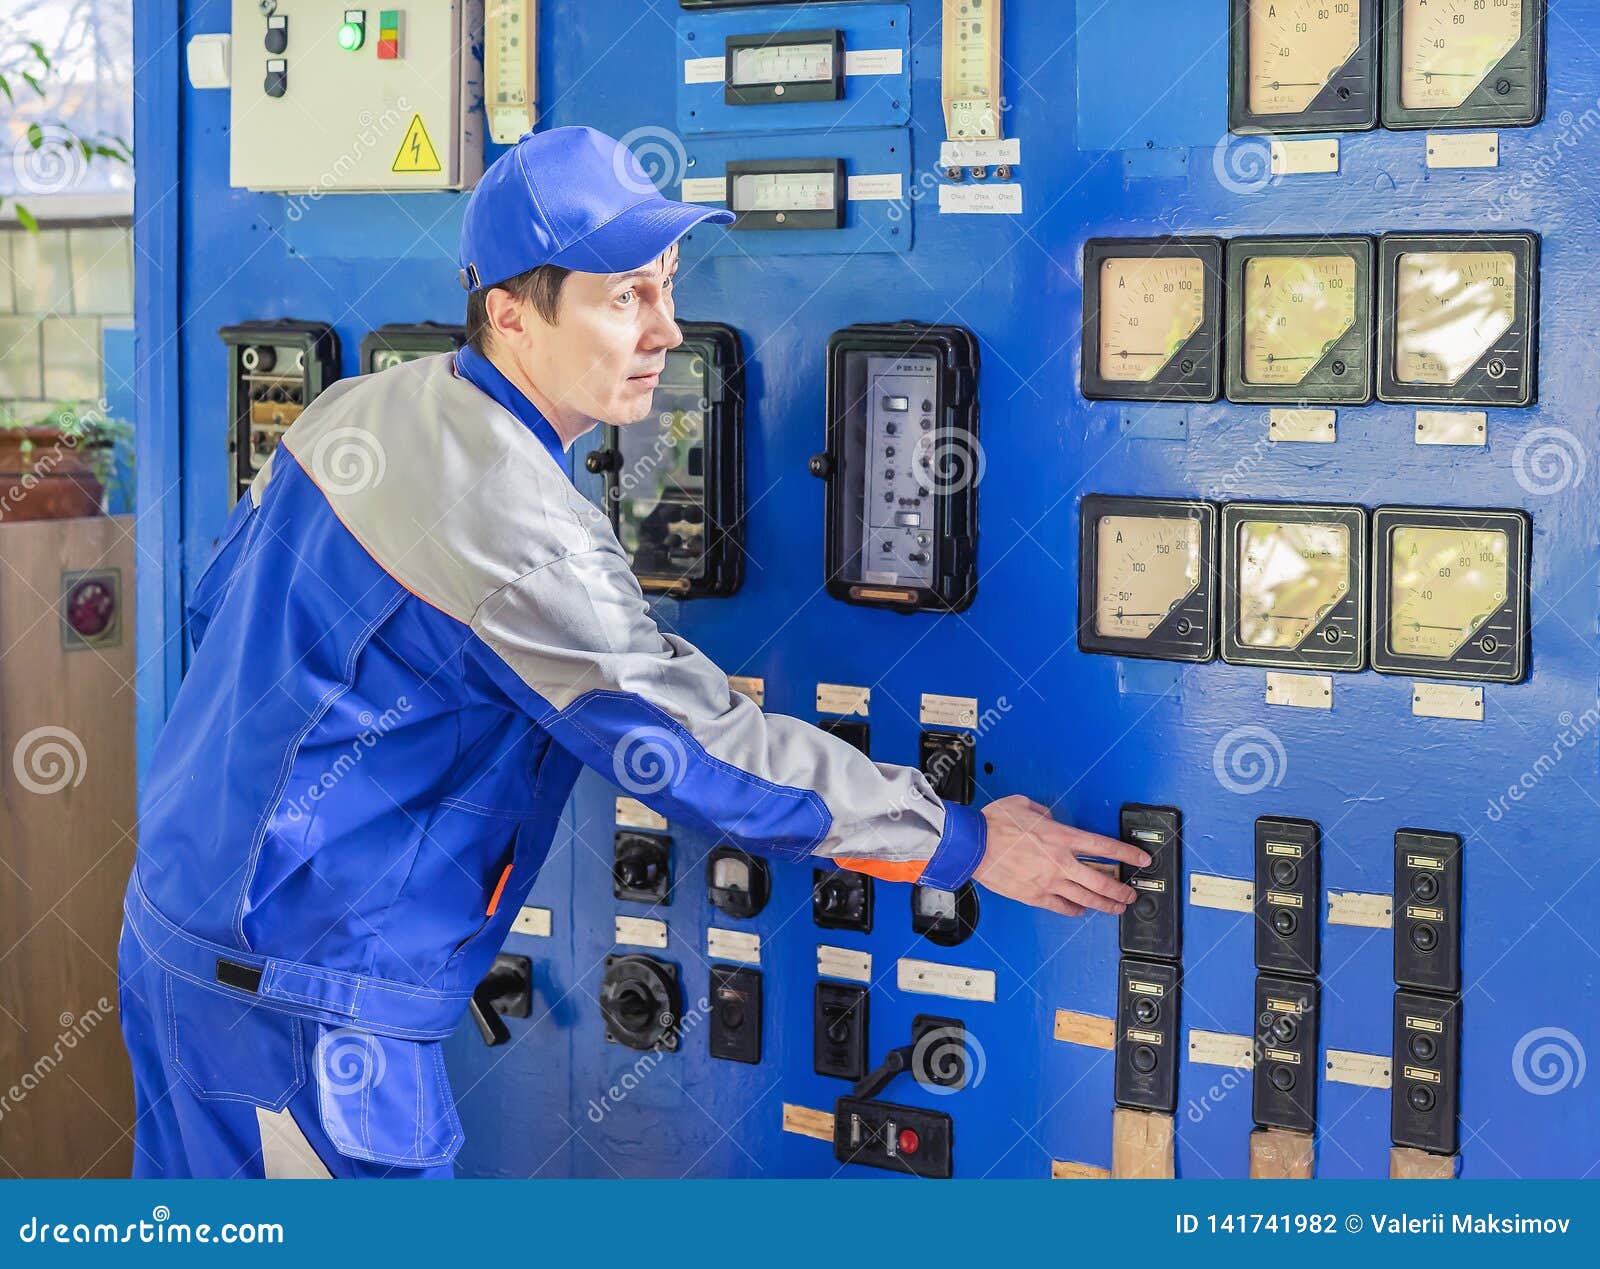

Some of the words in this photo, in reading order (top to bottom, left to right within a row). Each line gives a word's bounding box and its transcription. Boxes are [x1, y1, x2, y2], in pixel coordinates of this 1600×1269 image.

[1269, 5, 1276, 18] A
[1279, 47, 1289, 57] 40
[1295, 23, 1307, 32] 60
[1318, 9, 1329, 19] 80
[1334, 3, 1349, 13] 100
[1433, 38, 1445, 48] 40
[1453, 14, 1465, 24] 60
[1473, 0, 1485, 9] 80
[1119, 276, 1126, 288] A
[1263, 274, 1271, 288] A
[1291, 293, 1304, 303] 60
[1328, 279, 1343, 289] 100
[1128, 318, 1139, 327] 40
[1143, 293, 1155, 303] 60
[1163, 283, 1174, 293] 80
[1178, 280, 1192, 290] 100
[1116, 531, 1123, 543] A
[1411, 544, 1418, 556] A
[1119, 591, 1130, 601] 50
[1132, 562, 1146, 573] 100
[1156, 544, 1170, 554] 150
[1420, 590, 1433, 600] 40
[1439, 567, 1451, 578] 60
[1459, 556, 1471, 567] 80
[1480, 552, 1495, 562] 100
